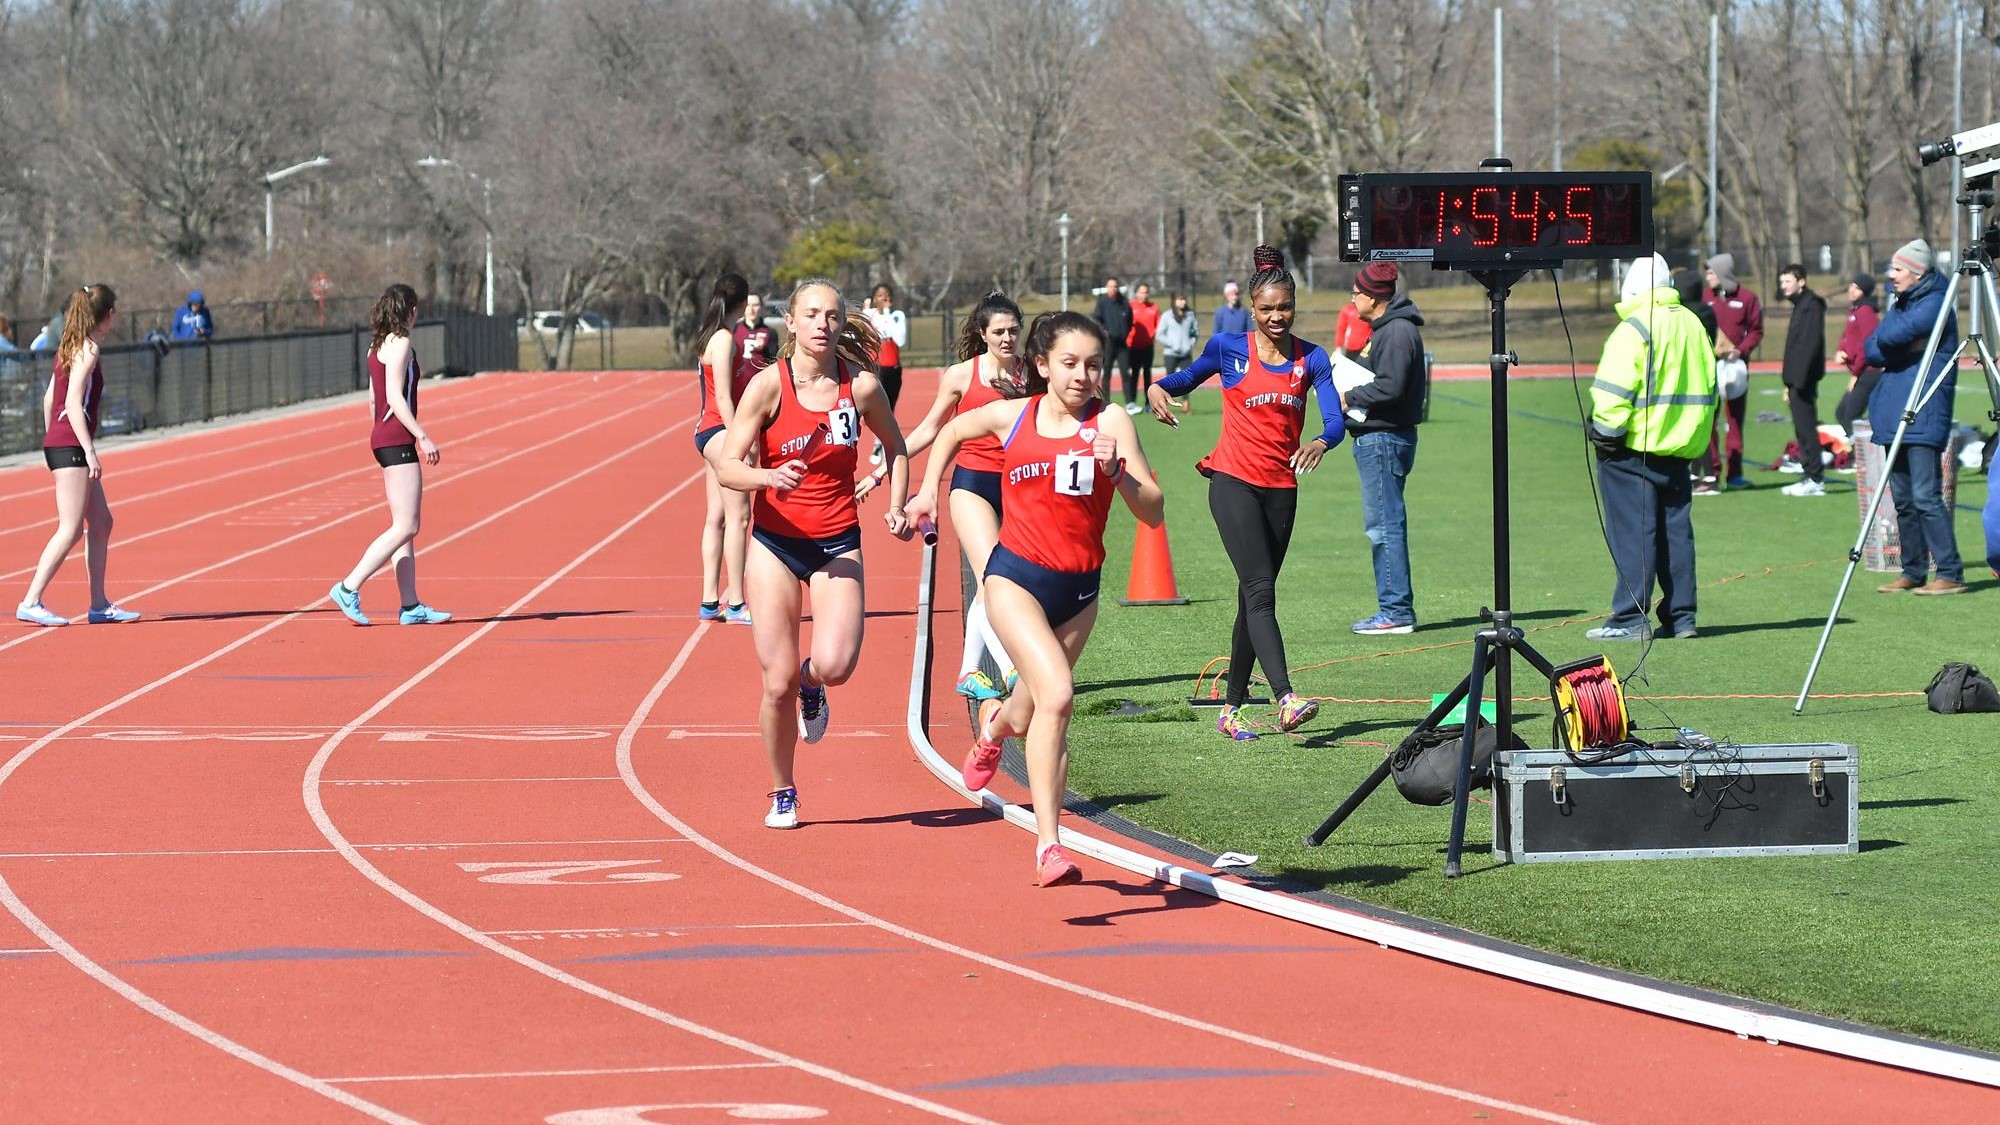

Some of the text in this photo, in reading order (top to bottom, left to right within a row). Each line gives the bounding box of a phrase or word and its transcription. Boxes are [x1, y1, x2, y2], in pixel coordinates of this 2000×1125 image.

[1245, 392, 1278, 408] STONY
[838, 411, 851, 440] 3
[781, 435, 812, 457] STON
[1009, 462, 1051, 486] STONY
[1068, 460, 1081, 492] 1
